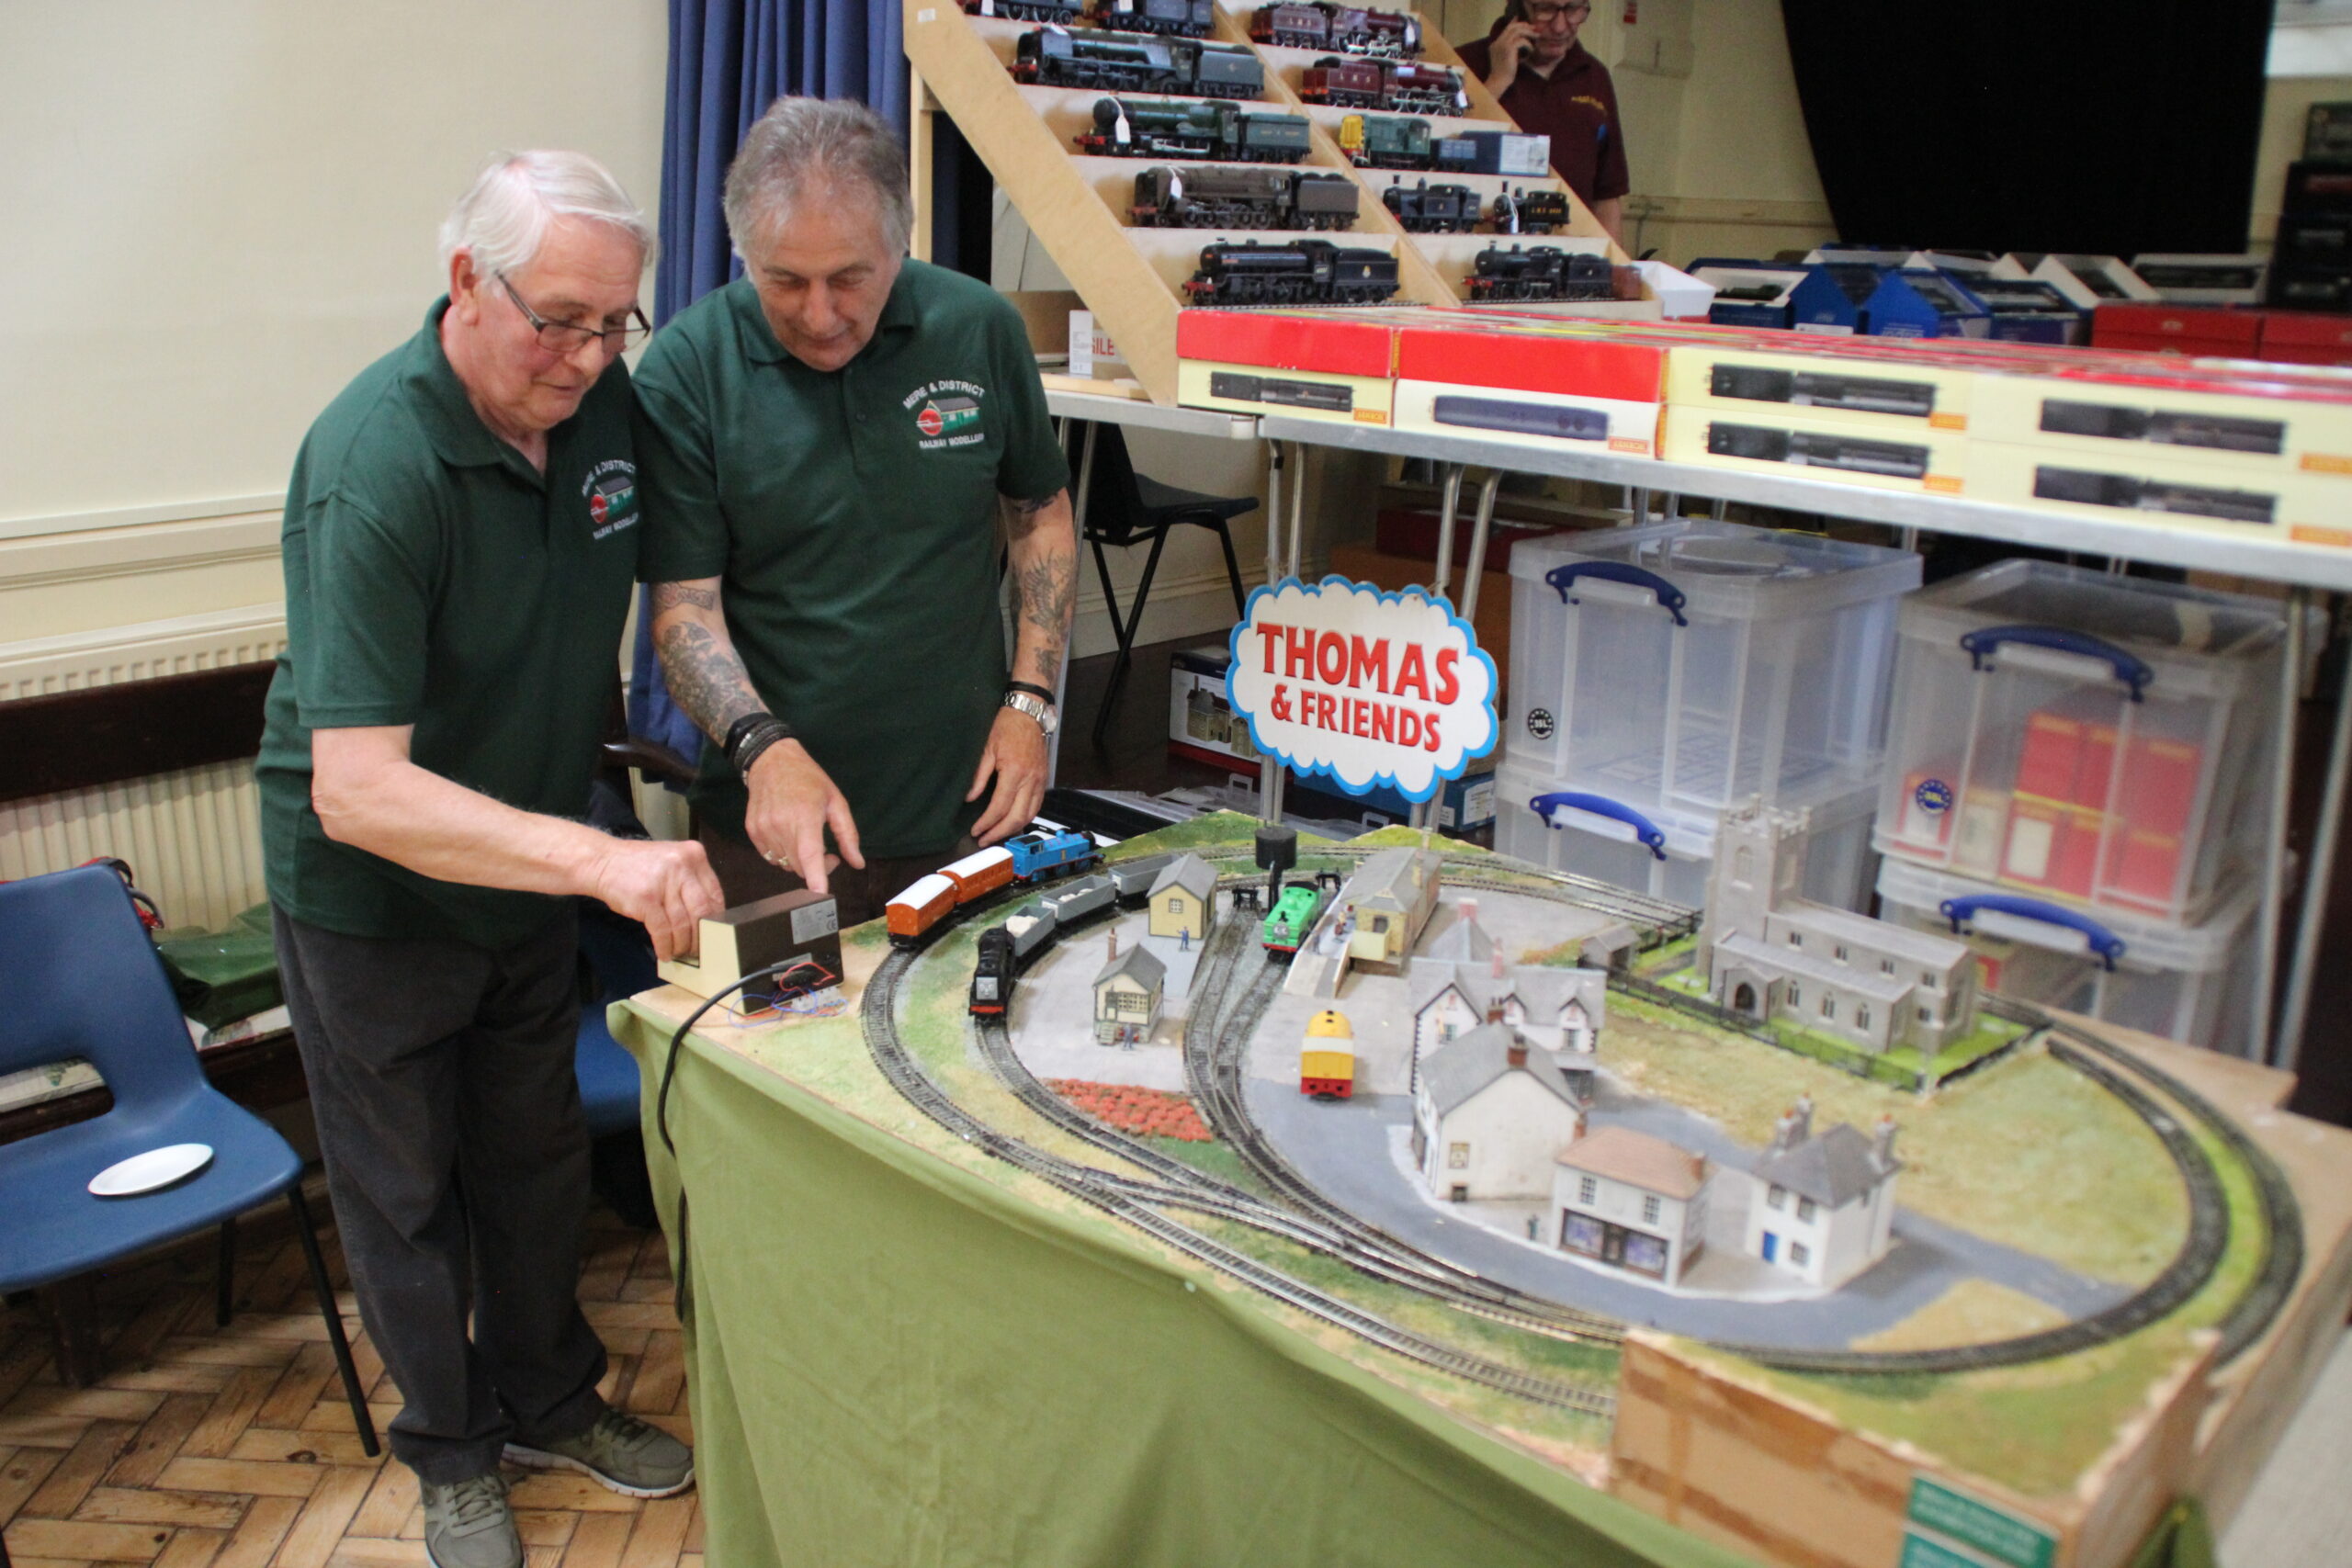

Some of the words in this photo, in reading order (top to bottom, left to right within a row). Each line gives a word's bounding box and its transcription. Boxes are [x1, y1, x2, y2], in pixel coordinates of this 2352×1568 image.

[903, 386, 928, 410] MERE
[938, 379, 985, 398] DISTRICT
[1257, 622, 1460, 705] THOMAS
[1271, 682, 1293, 723] &
[1300, 688, 1441, 752] FRIENDS
